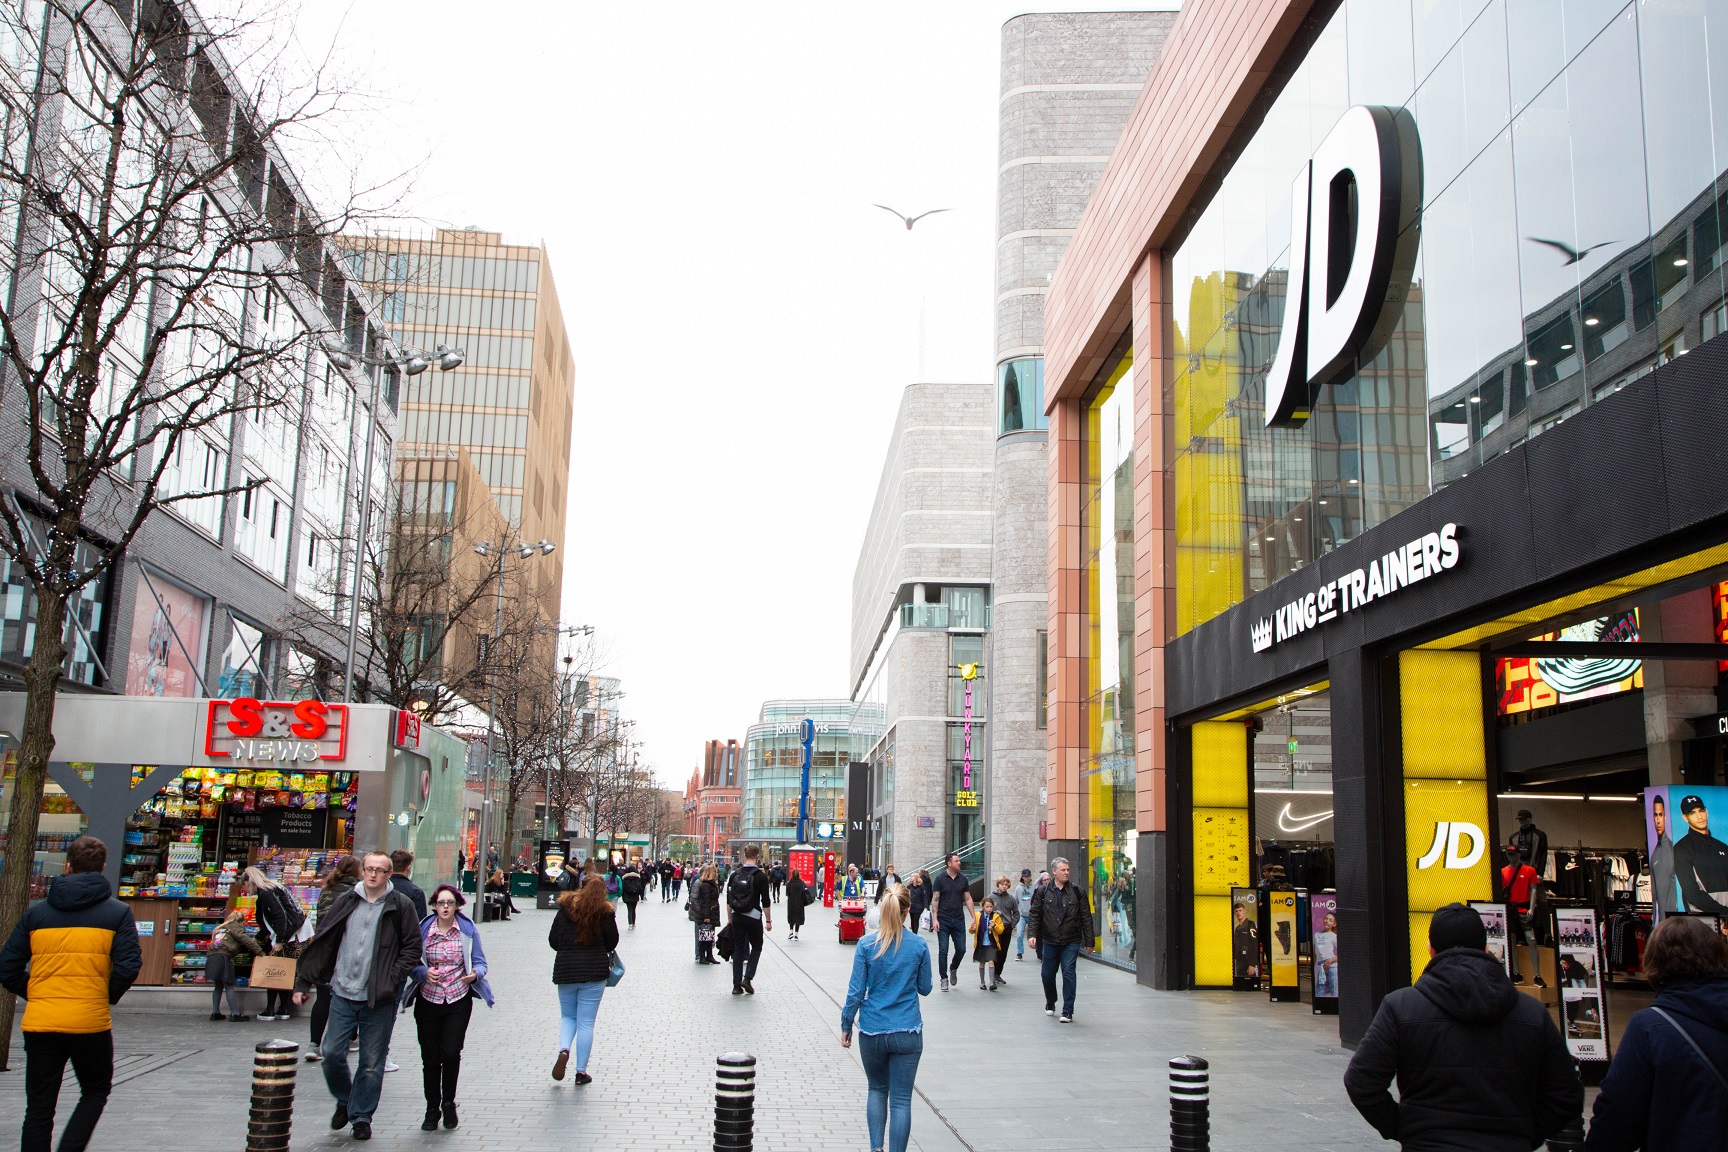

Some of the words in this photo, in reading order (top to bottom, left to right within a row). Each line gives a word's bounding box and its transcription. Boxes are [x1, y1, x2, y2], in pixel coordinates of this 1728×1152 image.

[1265, 105, 1408, 428] JD
[1275, 592, 1317, 643] KING
[1318, 581, 1338, 613] OF
[1338, 523, 1460, 614] TRAINERS
[226, 697, 327, 739] S&S
[775, 722, 797, 737] John
[963, 682, 973, 788] JUNKYARD
[231, 740, 319, 762] NEWS
[957, 791, 977, 799] GOLF
[957, 799, 977, 807] CLUB
[281, 819, 312, 827] Products
[284, 811, 312, 819] Tobacco
[852, 821, 863, 831] M
[1418, 822, 1485, 870] JD
